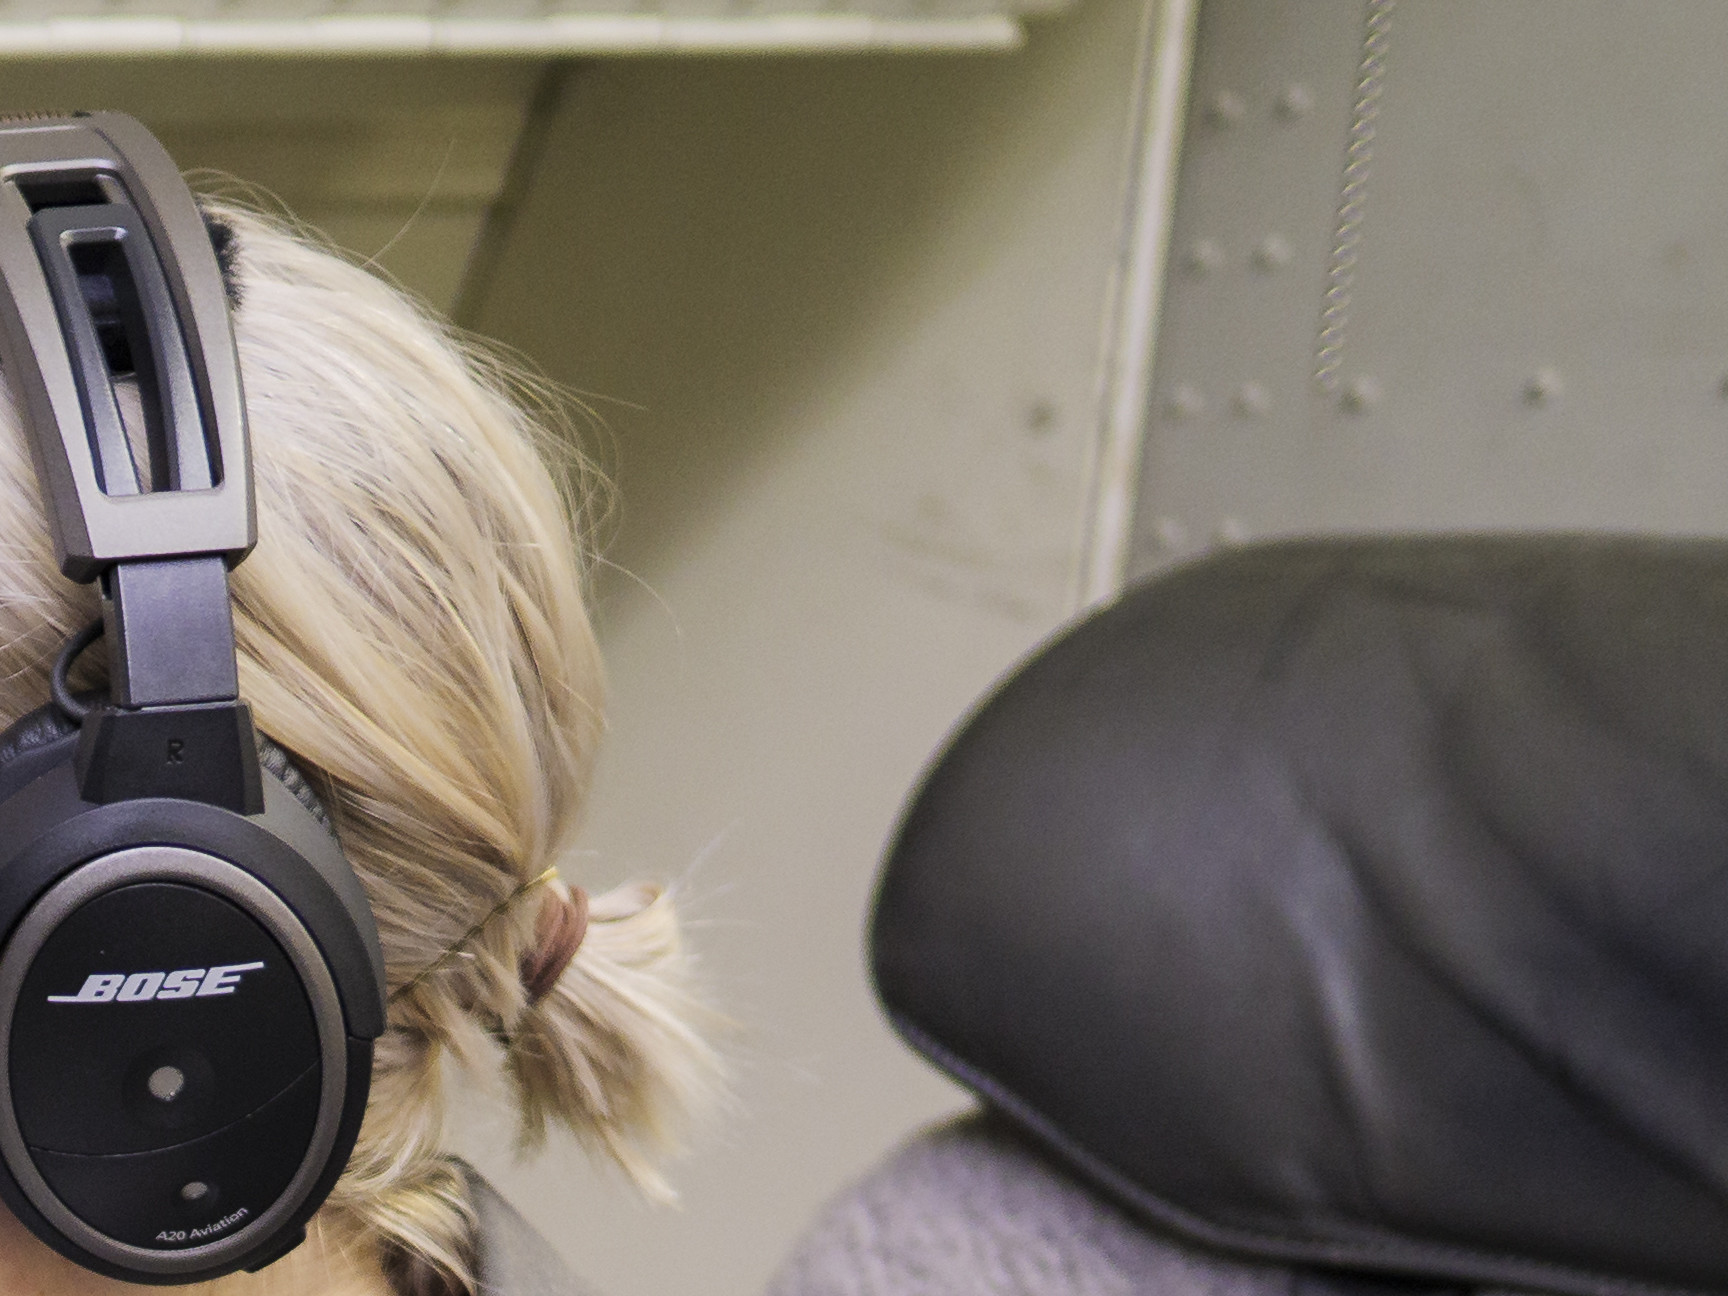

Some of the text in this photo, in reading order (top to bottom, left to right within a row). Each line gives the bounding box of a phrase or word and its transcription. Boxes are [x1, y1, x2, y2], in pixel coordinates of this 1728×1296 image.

[166, 738, 185, 764] R
[47, 961, 264, 1002] BOSE
[154, 1205, 250, 1243] A20 Aviation
